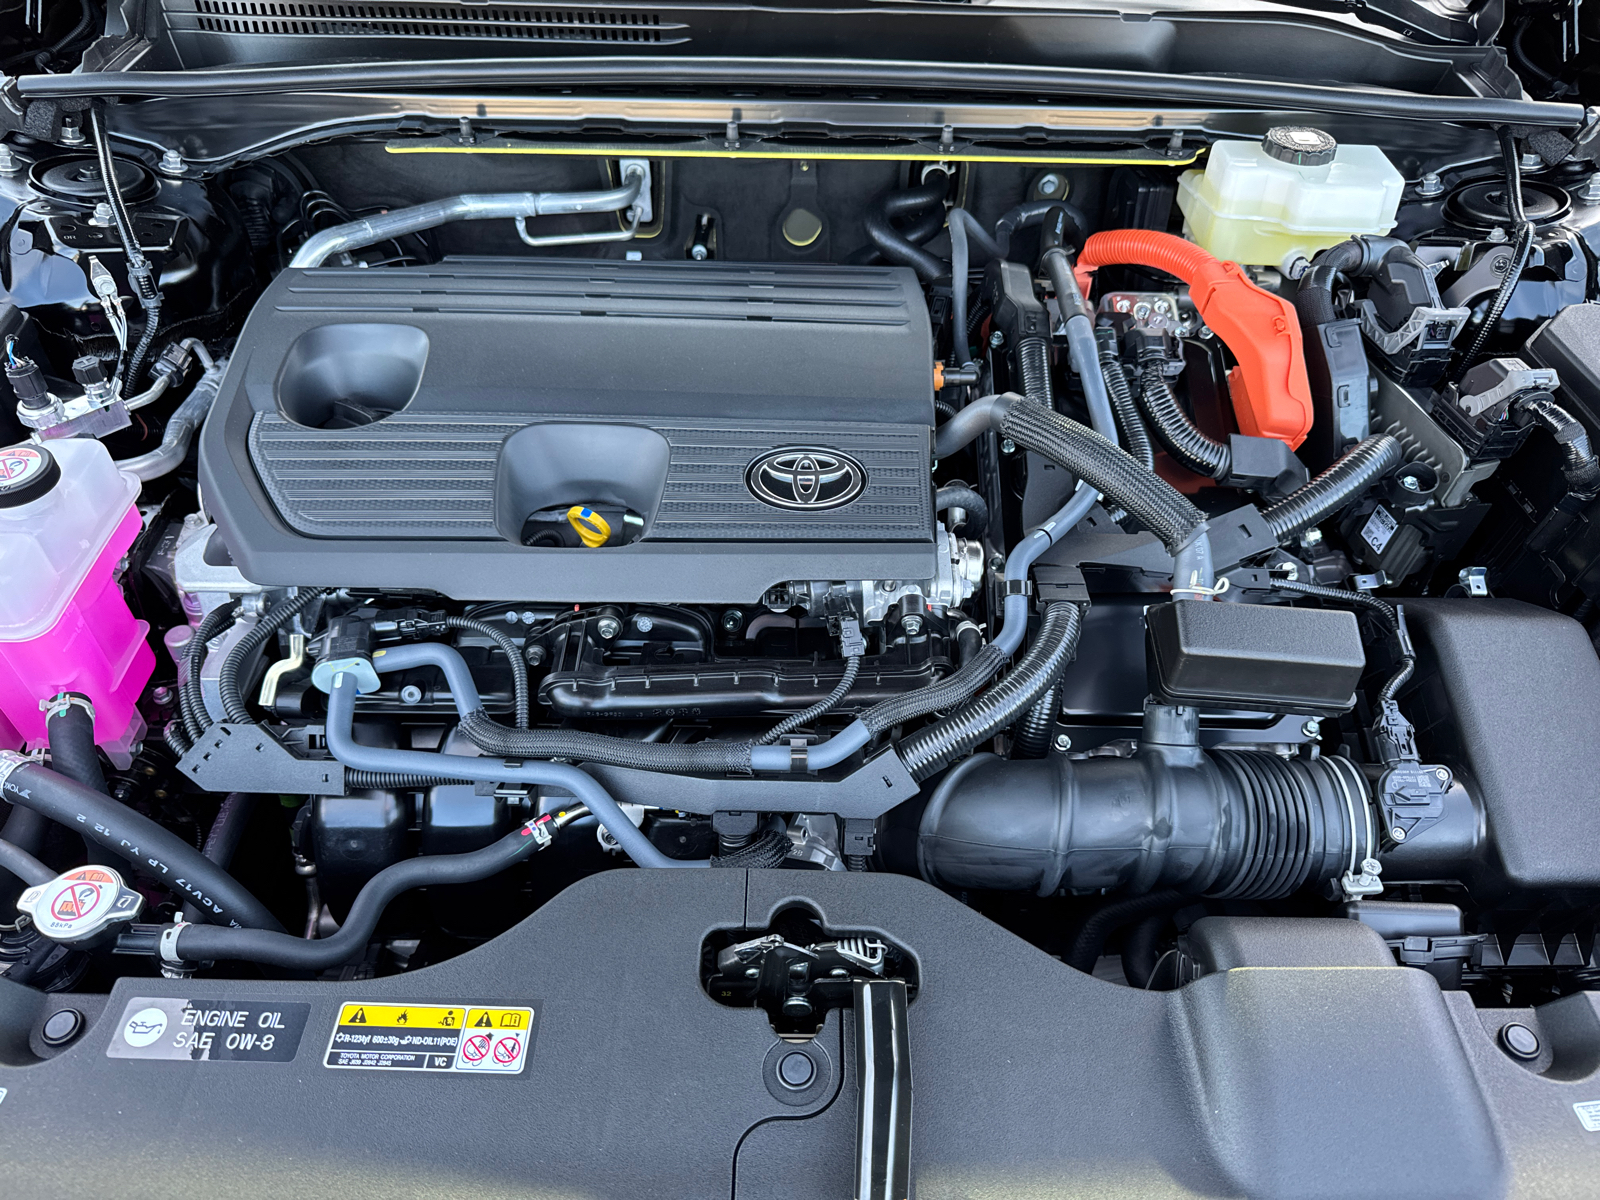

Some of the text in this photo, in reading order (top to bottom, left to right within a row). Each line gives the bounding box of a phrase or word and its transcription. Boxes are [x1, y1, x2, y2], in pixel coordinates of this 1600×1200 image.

[1371, 537, 1383, 551] C4
[76, 813, 224, 914] ACV17 LP YJ 12 2
[181, 1009, 286, 1029] ENGINE OIL
[172, 1031, 276, 1051] SAE 0W-8
[343, 1033, 371, 1046] R-1234yf
[434, 1056, 448, 1067] VC
